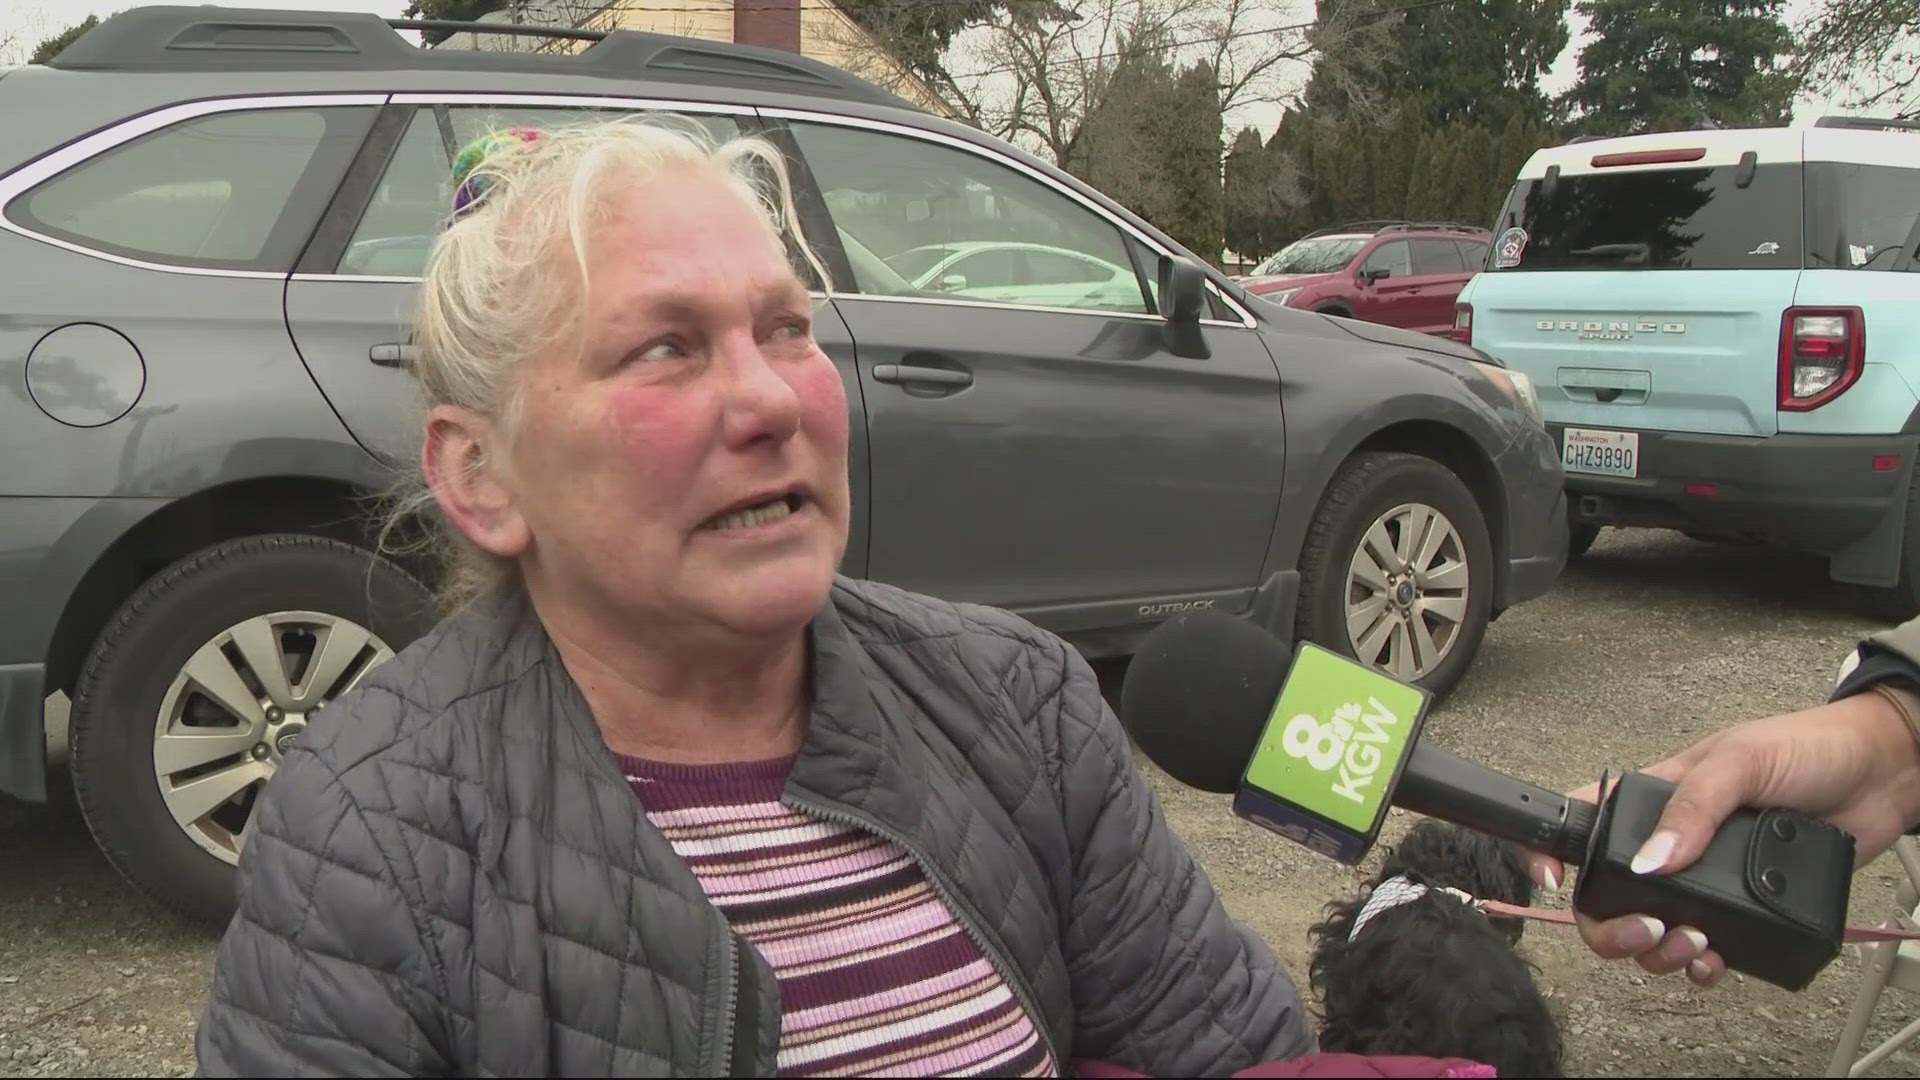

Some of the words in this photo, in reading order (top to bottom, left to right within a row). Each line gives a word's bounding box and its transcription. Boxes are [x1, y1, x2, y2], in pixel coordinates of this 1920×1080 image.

[1536, 320, 1685, 334] BRONCO
[1568, 434, 1609, 444] WASHINGTON
[1565, 444, 1633, 470] CHZ9890
[1138, 599, 1216, 615] OUTBACK
[1282, 713, 1346, 771] 8
[1331, 695, 1399, 805] KGW
